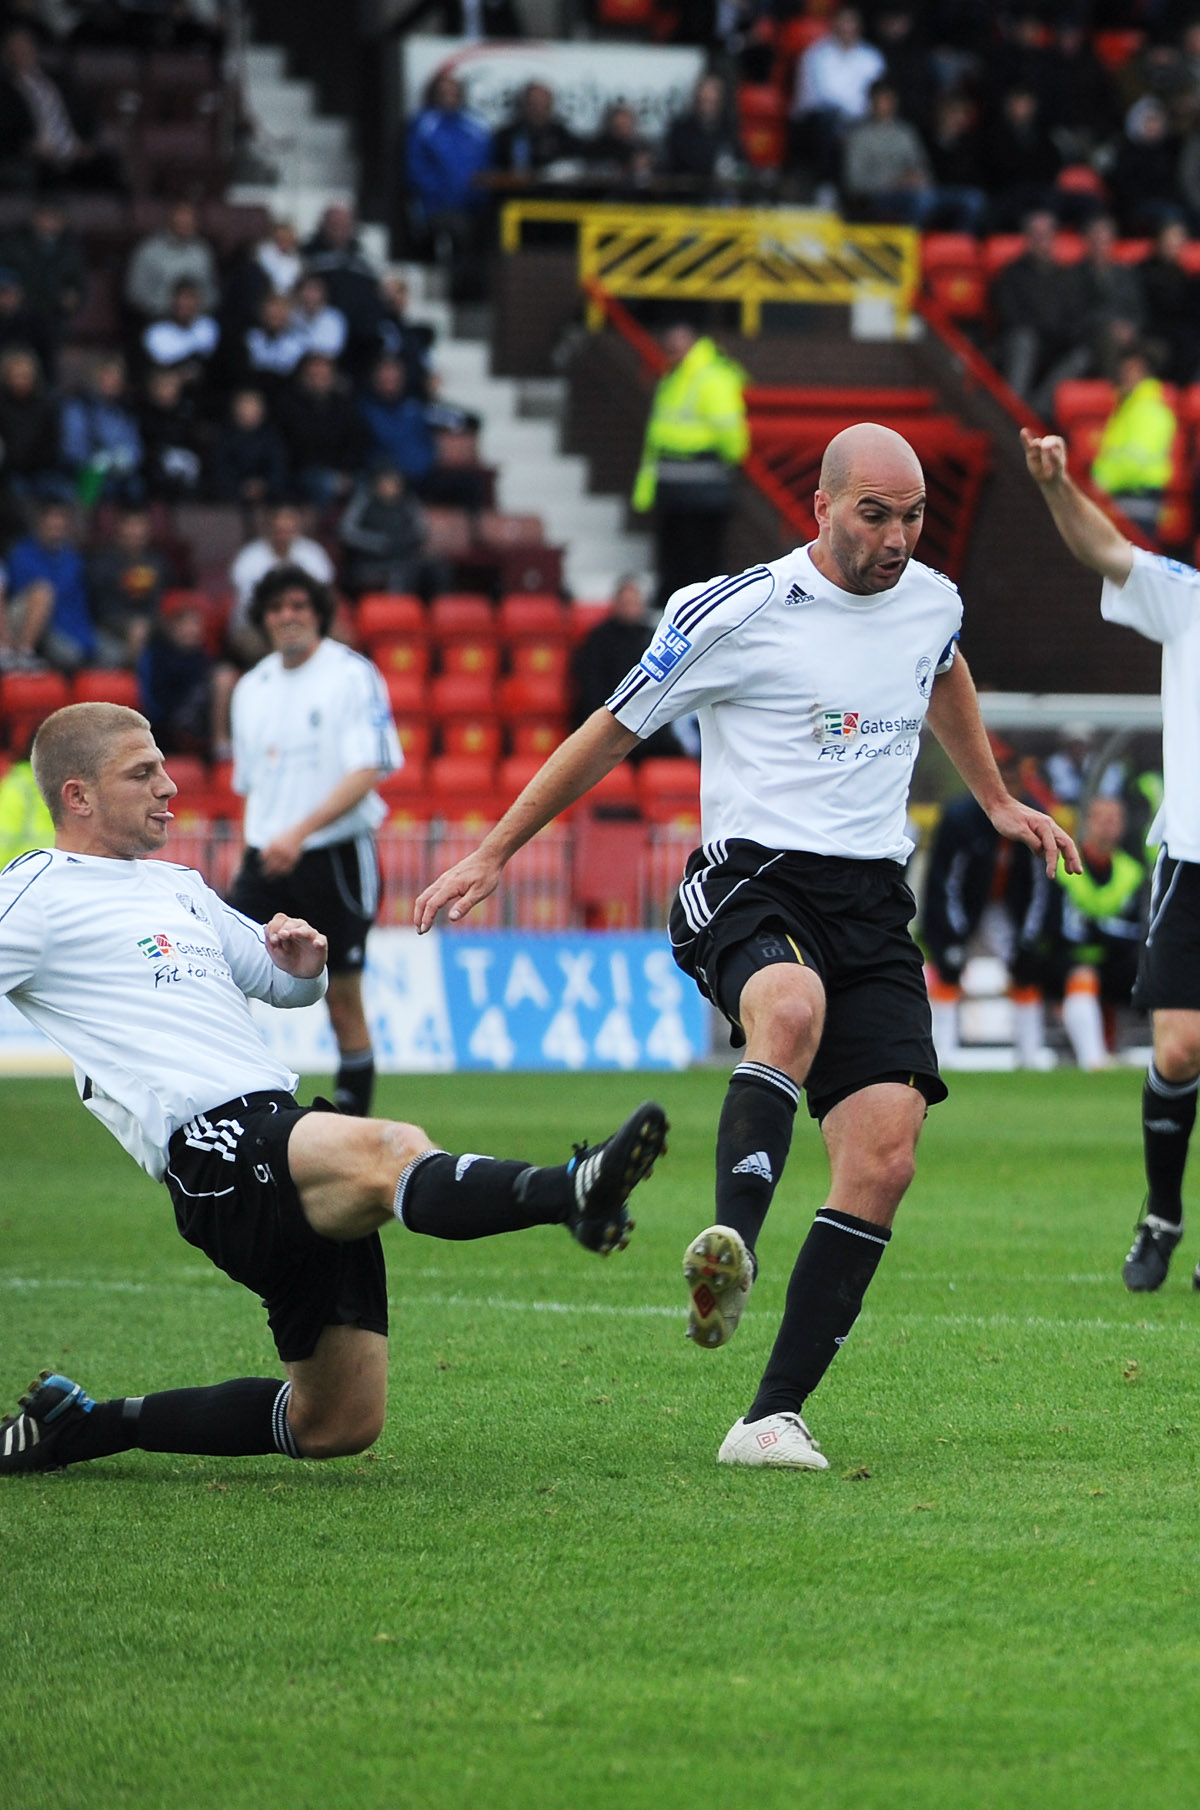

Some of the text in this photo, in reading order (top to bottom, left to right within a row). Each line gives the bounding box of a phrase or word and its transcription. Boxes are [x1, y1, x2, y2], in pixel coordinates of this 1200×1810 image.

[817, 744, 847, 762] Fit
[153, 963, 183, 989] Fit
[455, 948, 684, 1011] TAXIS
[731, 1164, 773, 1183] adidas
